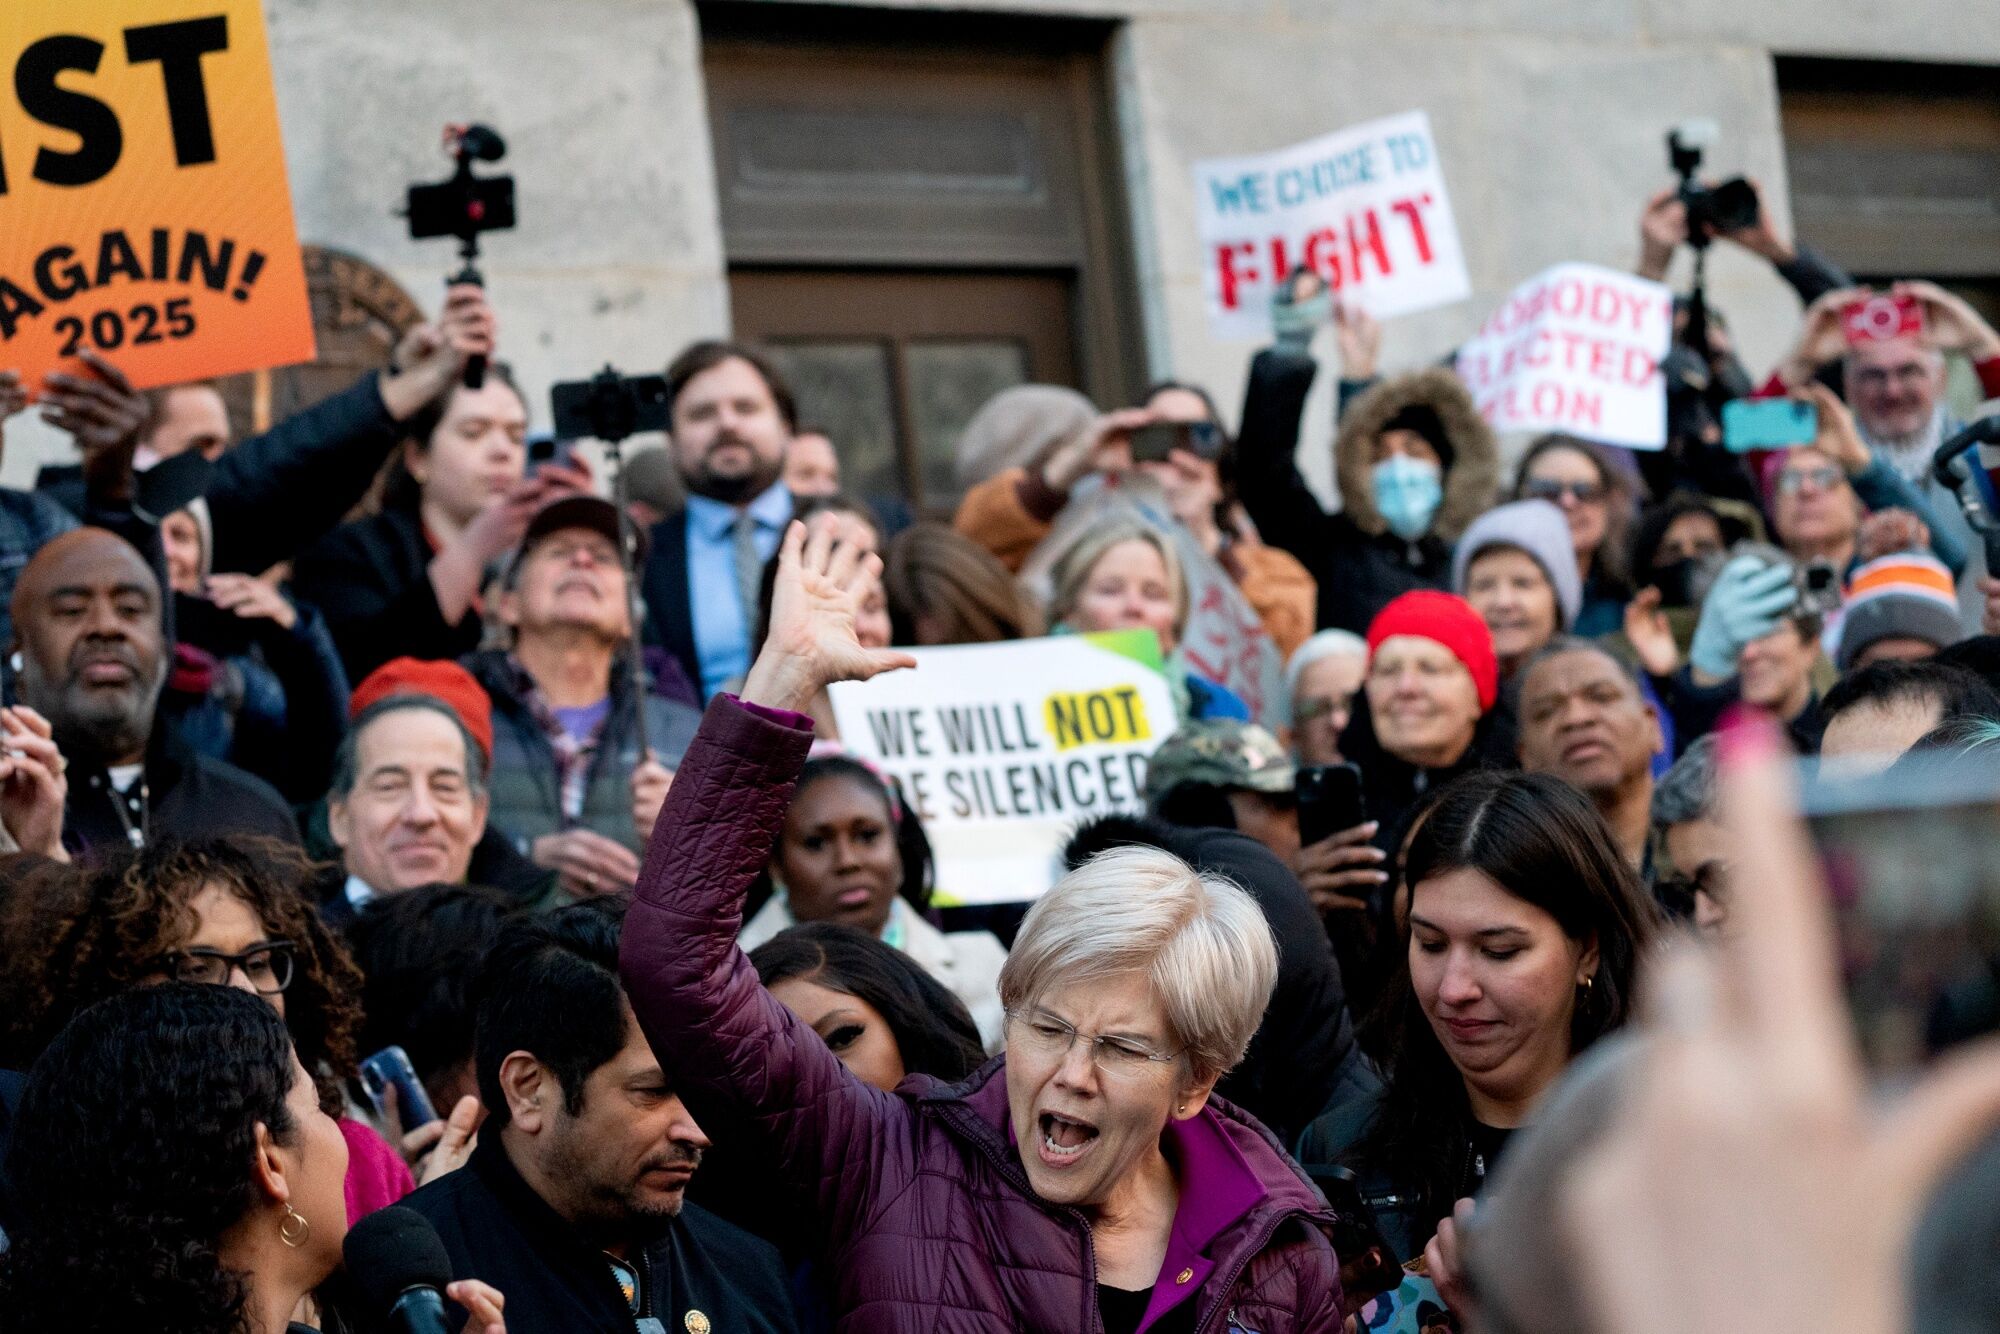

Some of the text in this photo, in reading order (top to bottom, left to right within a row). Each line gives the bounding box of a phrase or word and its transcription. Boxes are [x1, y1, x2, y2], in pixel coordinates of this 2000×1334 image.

[0, 14, 228, 194] ST
[1210, 171, 1268, 214] WE
[1386, 131, 1430, 176] TO
[0, 227, 267, 341] AGAIN!
[1216, 192, 1434, 309] FIGHT
[54, 296, 196, 357] 2025
[866, 687, 1140, 757] WE WILL NOT
